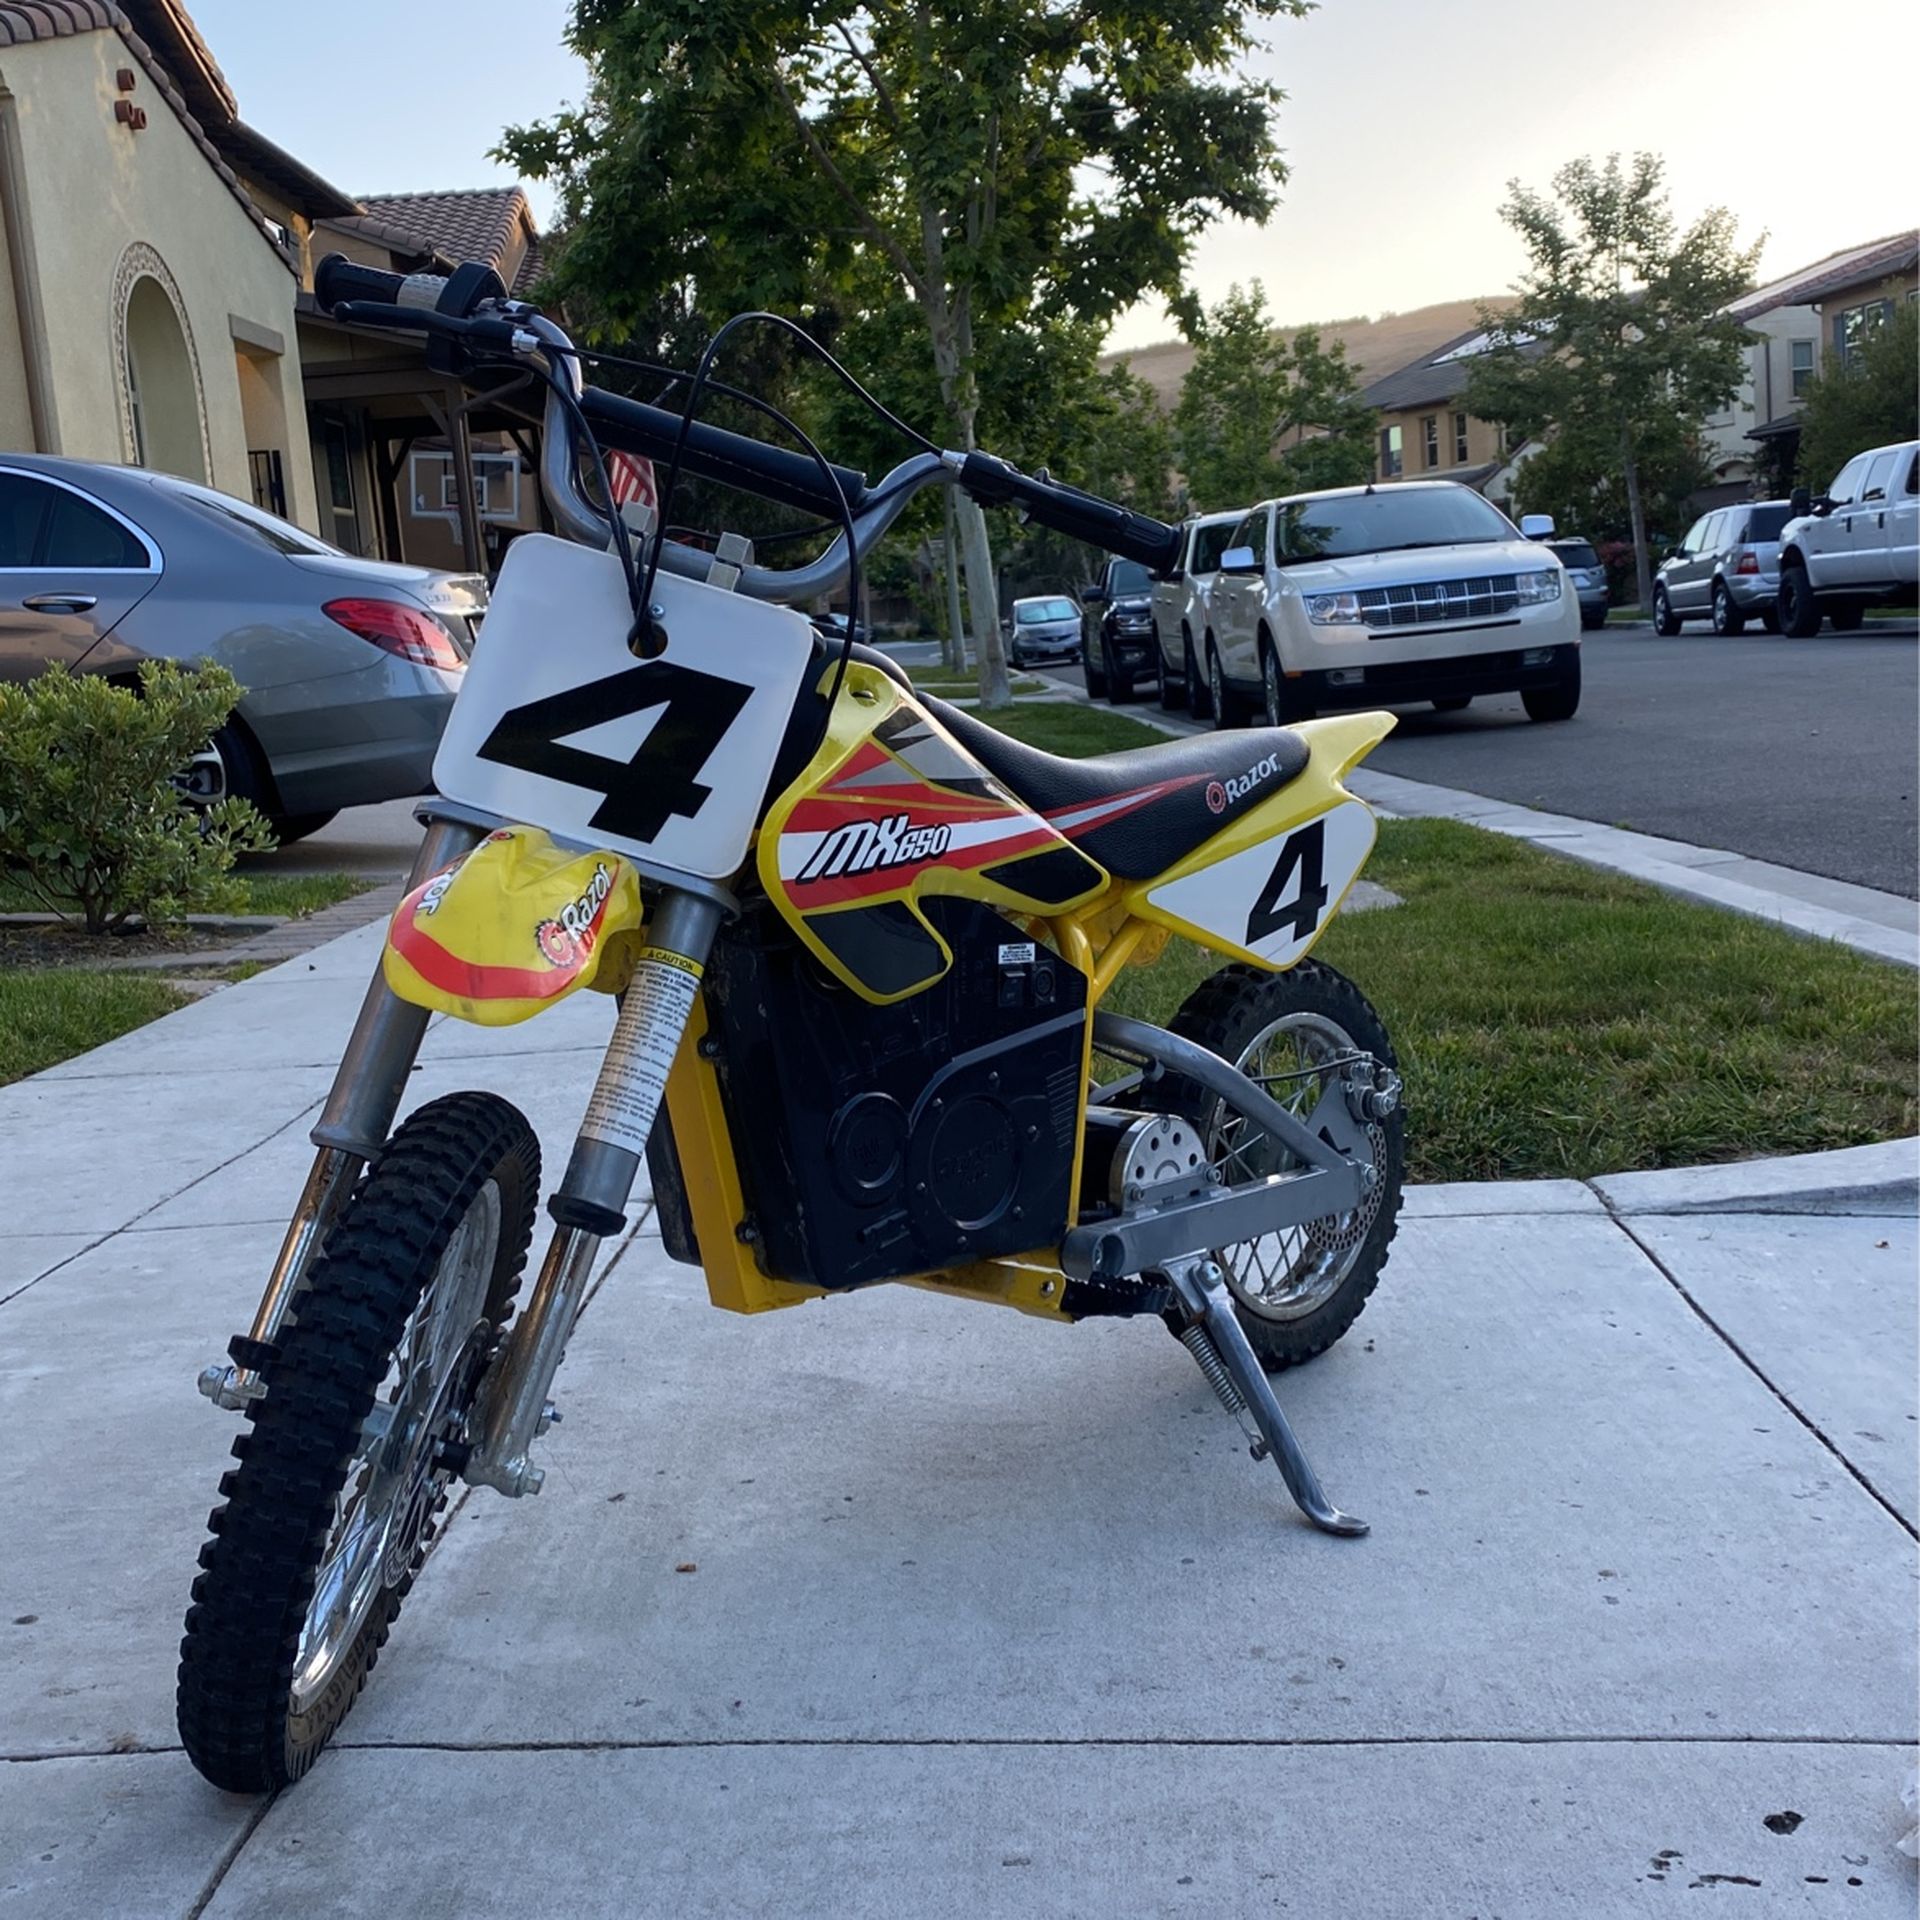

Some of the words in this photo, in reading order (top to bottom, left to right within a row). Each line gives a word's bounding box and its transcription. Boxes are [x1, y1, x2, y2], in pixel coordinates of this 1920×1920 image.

[476, 660, 755, 844] 4
[1223, 753, 1279, 804] Razor
[795, 813, 951, 884] MX650
[1245, 818, 1328, 946] 4
[560, 862, 610, 942] Razor
[655, 951, 695, 972] CAUTION
